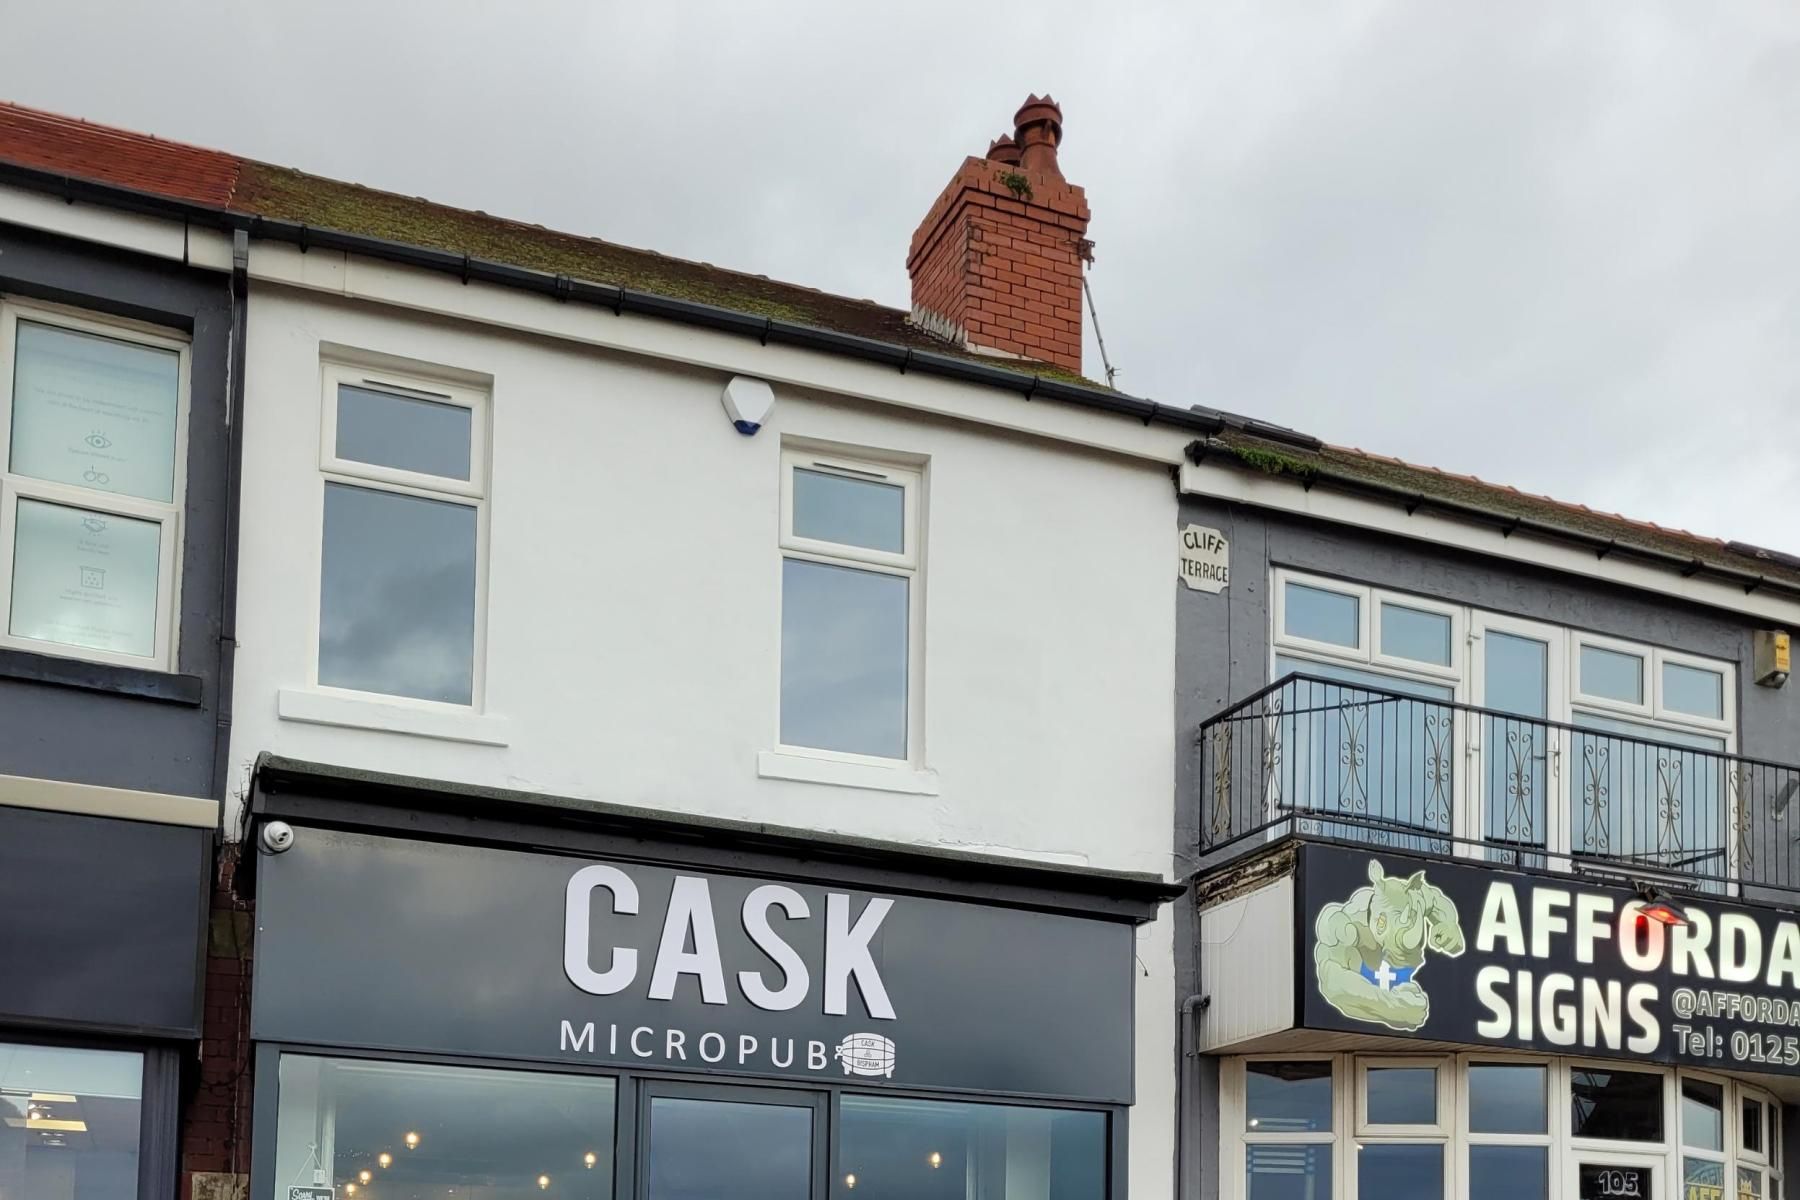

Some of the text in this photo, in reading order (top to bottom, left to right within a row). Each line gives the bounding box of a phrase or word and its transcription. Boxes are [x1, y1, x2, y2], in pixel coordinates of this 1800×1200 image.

[1183, 531, 1225, 554] CLIFF
[1181, 558, 1228, 583] TERRACE
[563, 864, 897, 1020] CASK
[1475, 880, 1800, 989] AFFORDA
[1475, 964, 1661, 1055] SIGNS
[559, 1020, 828, 1070] MICROPUB
[1672, 1024, 1800, 1066] Tel: 0125
[1599, 1170, 1641, 1197] 105
